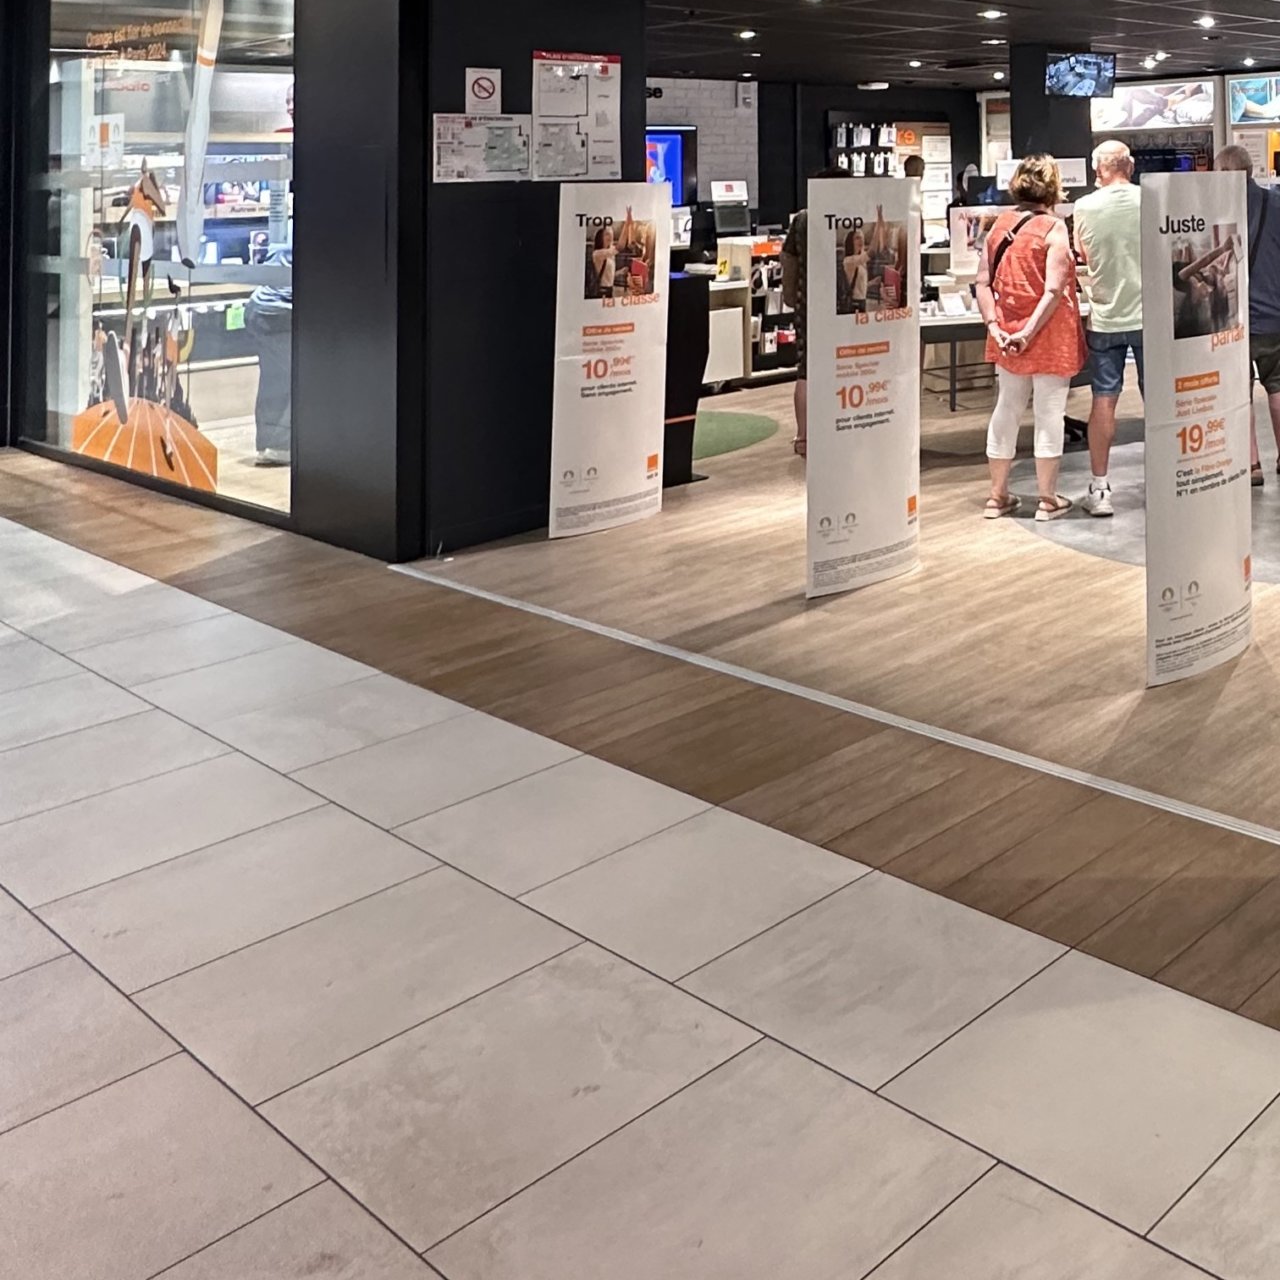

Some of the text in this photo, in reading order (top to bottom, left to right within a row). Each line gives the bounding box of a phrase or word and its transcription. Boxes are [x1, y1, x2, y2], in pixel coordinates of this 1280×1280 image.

[576, 213, 613, 230] Trop
[824, 214, 864, 231] Trop
[1159, 214, 1206, 234] Juste
[602, 292, 660, 308] la classe
[855, 306, 913, 325] la classe
[1211, 322, 1245, 352] parfait
[582, 358, 608, 379] 10
[836, 384, 864, 409] 10
[1176, 424, 1203, 454] 19
[1176, 468, 1194, 478] C'est
